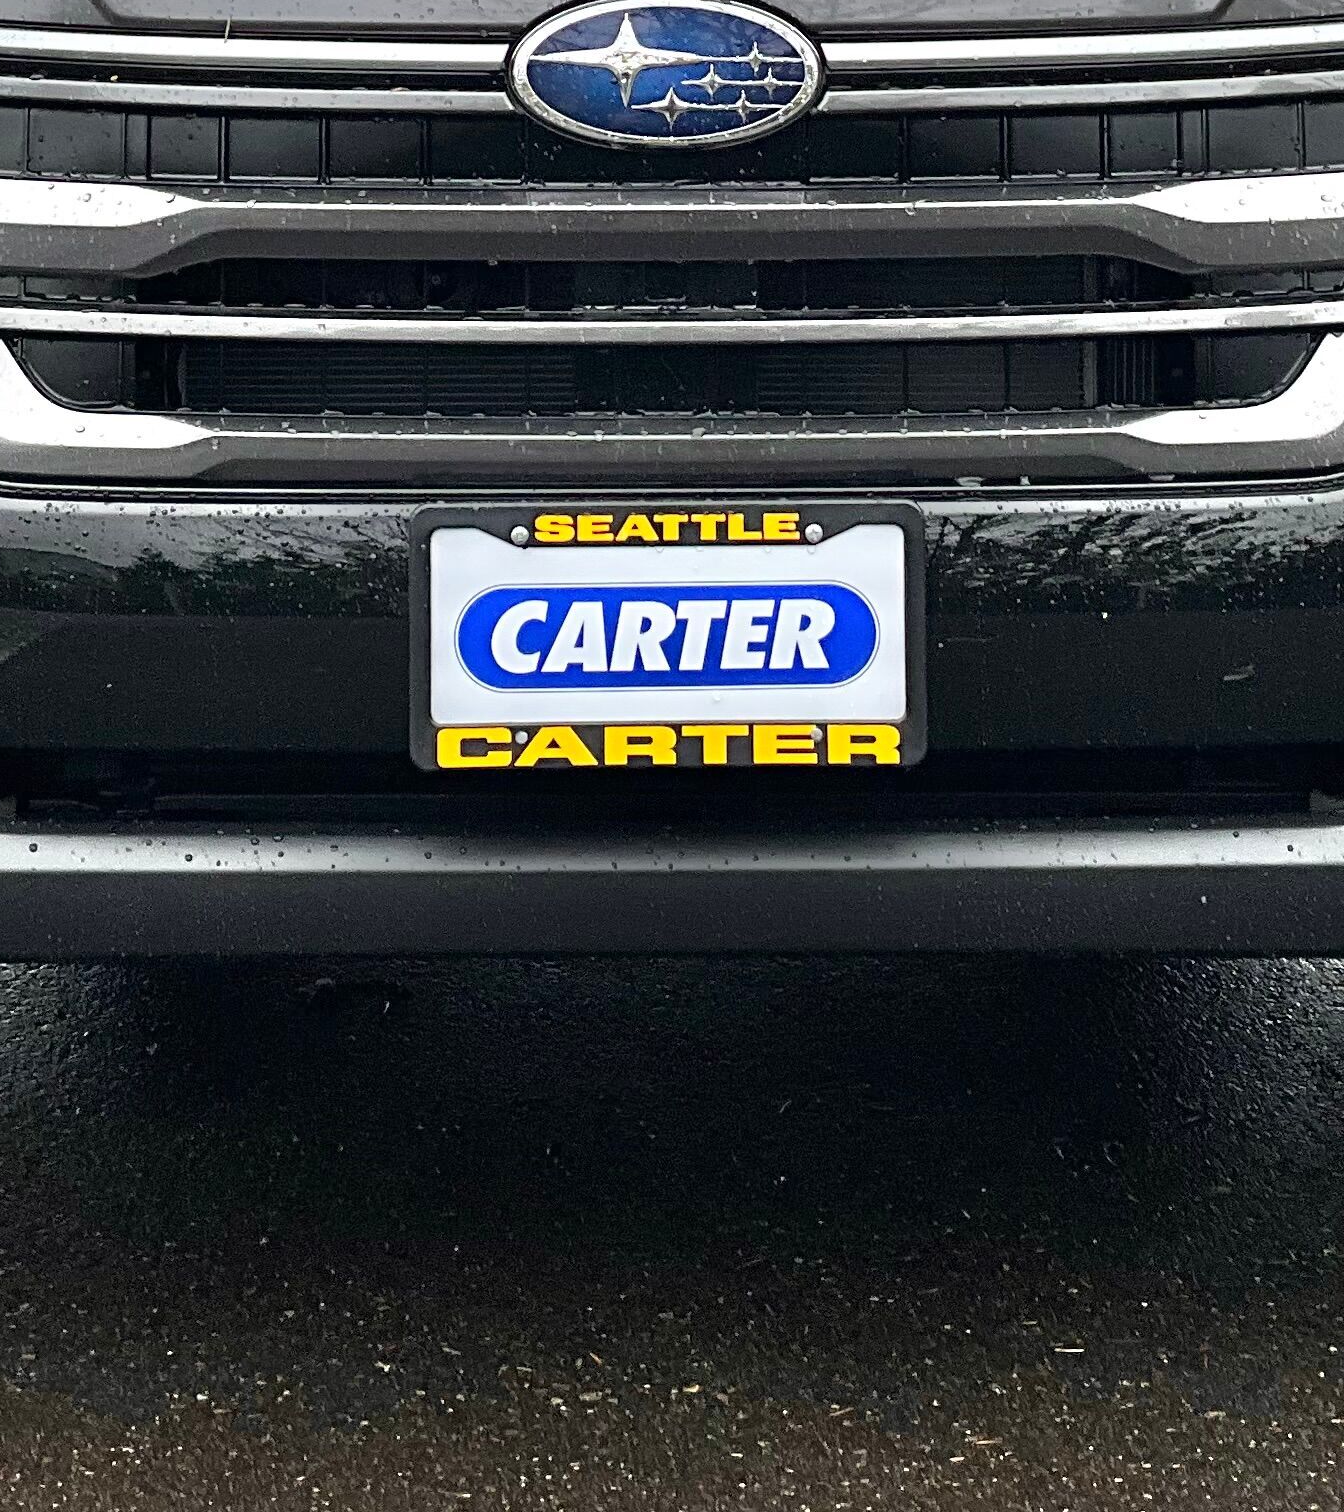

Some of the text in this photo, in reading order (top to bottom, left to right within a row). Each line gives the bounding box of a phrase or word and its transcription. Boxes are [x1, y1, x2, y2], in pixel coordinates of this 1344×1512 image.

[534, 512, 801, 543] SEATTLE
[491, 599, 836, 674] CARTER
[435, 724, 902, 769] CARTER
